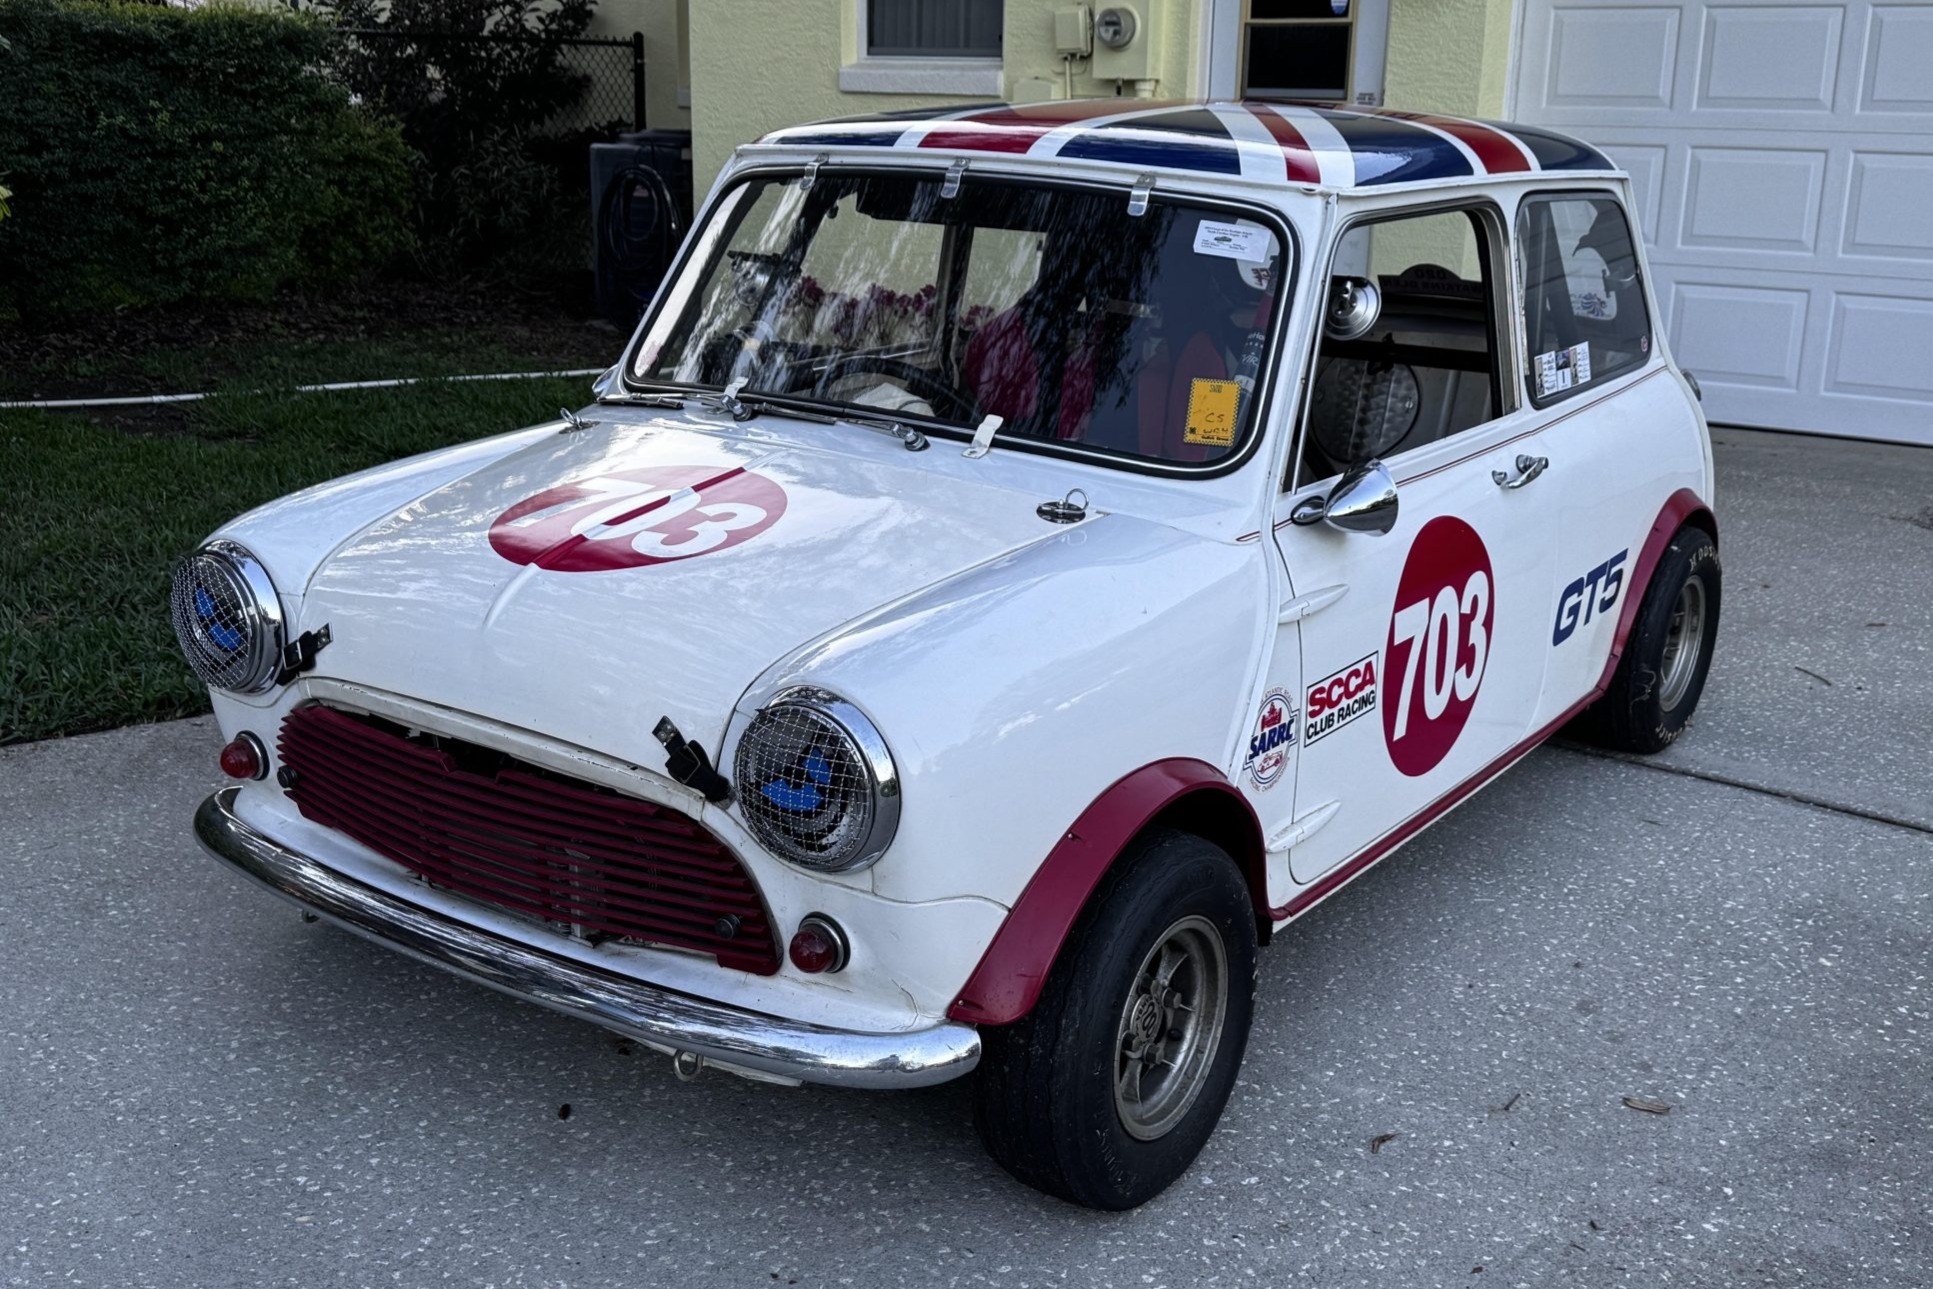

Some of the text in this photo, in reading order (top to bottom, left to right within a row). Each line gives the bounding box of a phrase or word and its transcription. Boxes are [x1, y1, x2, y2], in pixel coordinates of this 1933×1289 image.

[505, 476, 768, 558] 703
[1552, 547, 1629, 647] GT5
[1308, 660, 1376, 719] SCCA
[1393, 570, 1489, 742] 703
[1248, 718, 1295, 761] SARRC
[1306, 690, 1376, 740] CLUB RACING
